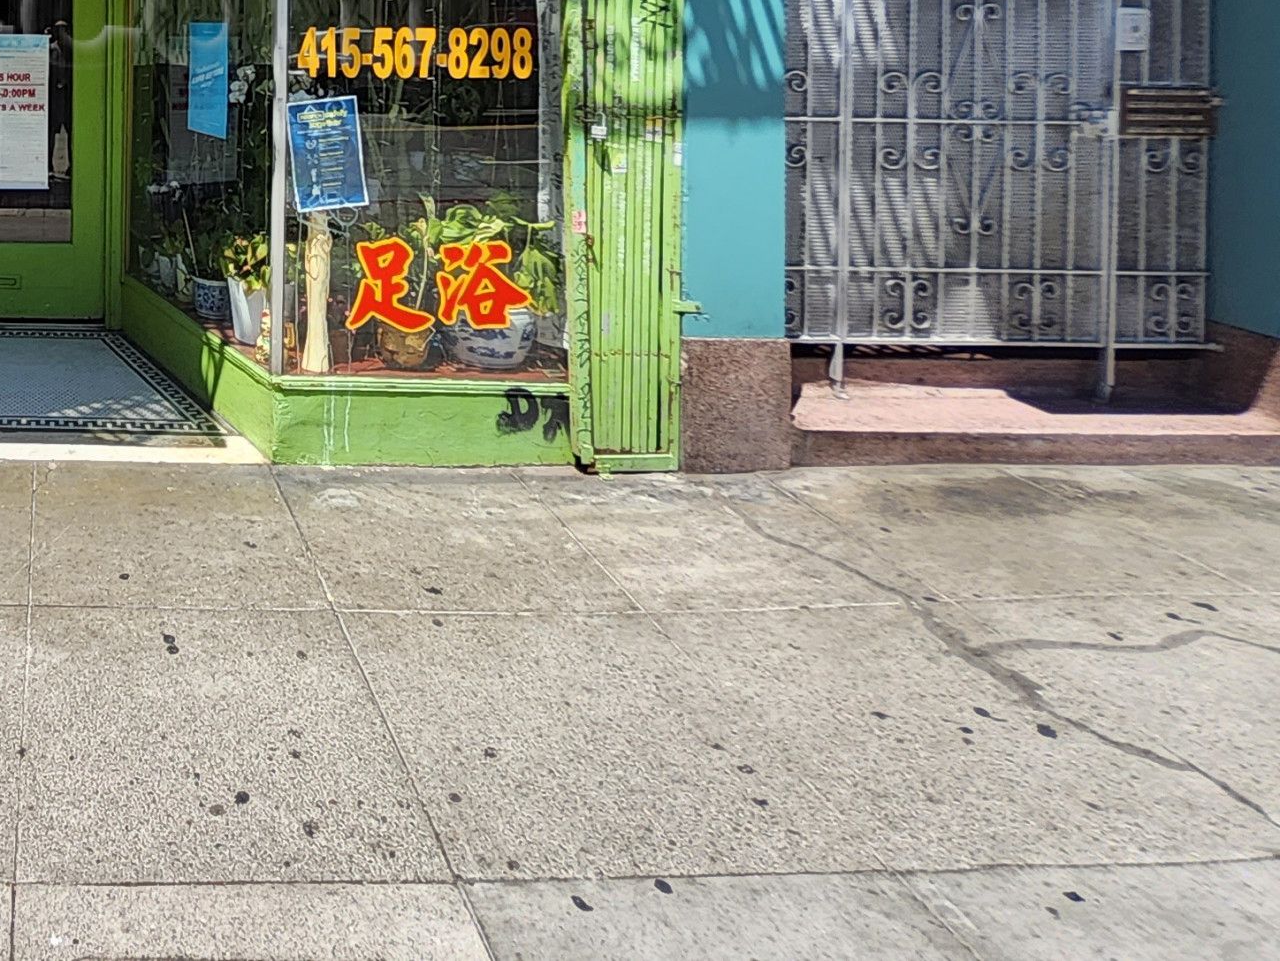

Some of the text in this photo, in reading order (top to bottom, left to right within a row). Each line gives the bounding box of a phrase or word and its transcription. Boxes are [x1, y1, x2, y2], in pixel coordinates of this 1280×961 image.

[7, 72, 31, 82] HOUR
[297, 26, 534, 79] 415-567-8298
[346, 237, 531, 332] 足浴
